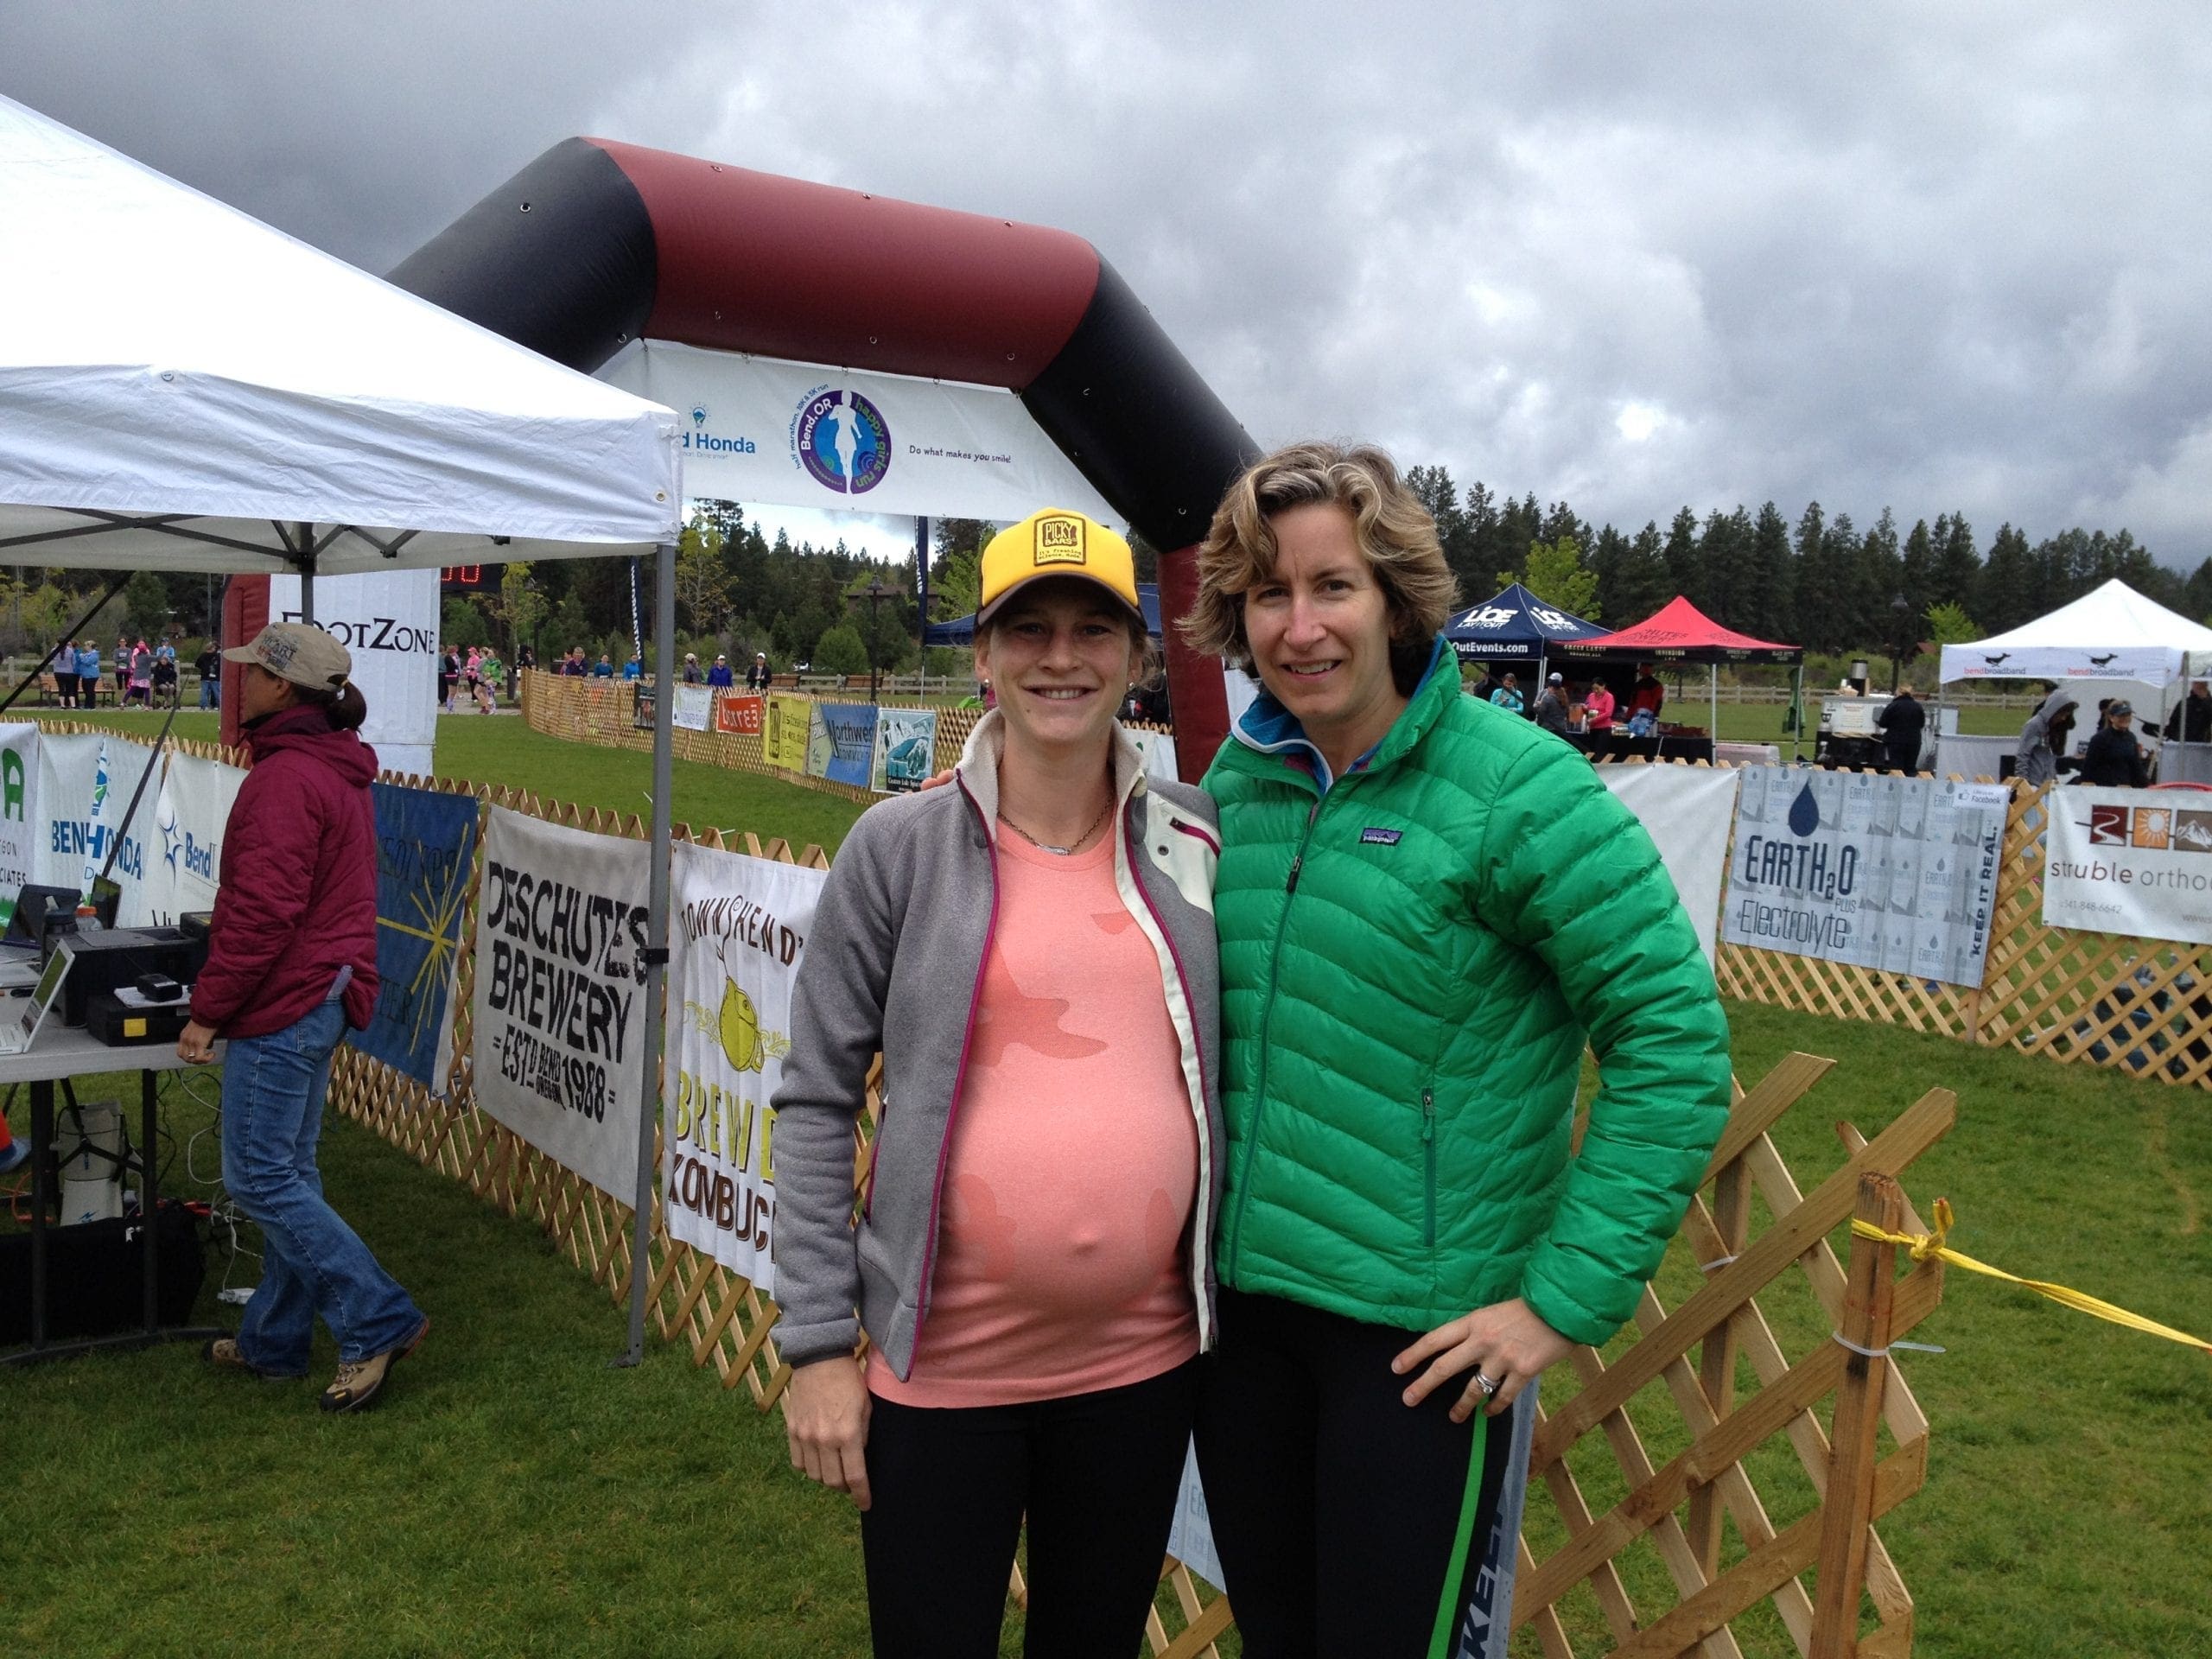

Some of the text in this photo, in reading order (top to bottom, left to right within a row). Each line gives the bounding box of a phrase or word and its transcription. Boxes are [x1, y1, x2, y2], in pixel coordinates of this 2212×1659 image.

[800, 397, 833, 451] Bend, OR
[696, 432, 756, 454] Honda
[855, 397, 888, 488] happy girls run
[909, 444, 1012, 464] Do what makes you smile!
[1045, 522, 1073, 546] PICKY BARS
[1964, 667, 2026, 676] bendbroadband
[2067, 668, 2135, 677] bendbroadband
[1971, 795, 2001, 804] Facebook
[1972, 826, 1998, 956] KEEP IT REAL.
[2050, 861, 2212, 892] struble ortho
[1834, 897, 1857, 914] PLUS
[487, 861, 650, 987] DESCHUTES
[1739, 899, 1847, 954] Electrolyte
[489, 938, 633, 1064] BREWERY
[537, 1042, 562, 1083] BEND
[562, 1054, 606, 1124] 1988
